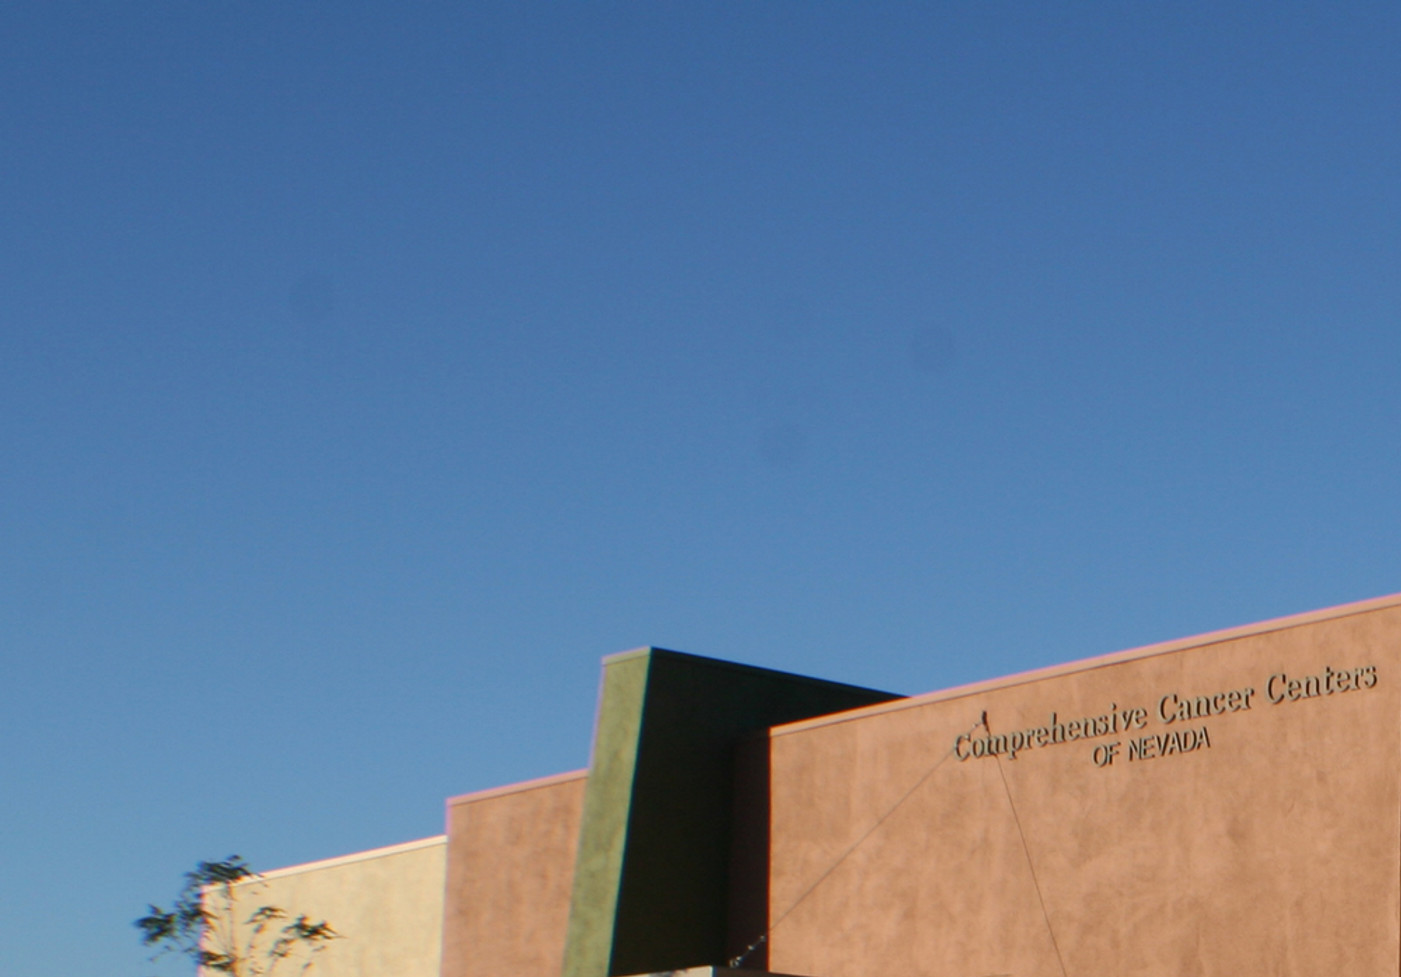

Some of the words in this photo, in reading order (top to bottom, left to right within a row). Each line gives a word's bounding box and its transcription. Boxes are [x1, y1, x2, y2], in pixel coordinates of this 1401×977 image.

[954, 702, 1148, 762] Comprehensive
[1157, 687, 1254, 724] Cancer
[1266, 665, 1378, 705] Centers
[1092, 742, 1121, 767] OF
[1128, 726, 1211, 762] NEVADA
